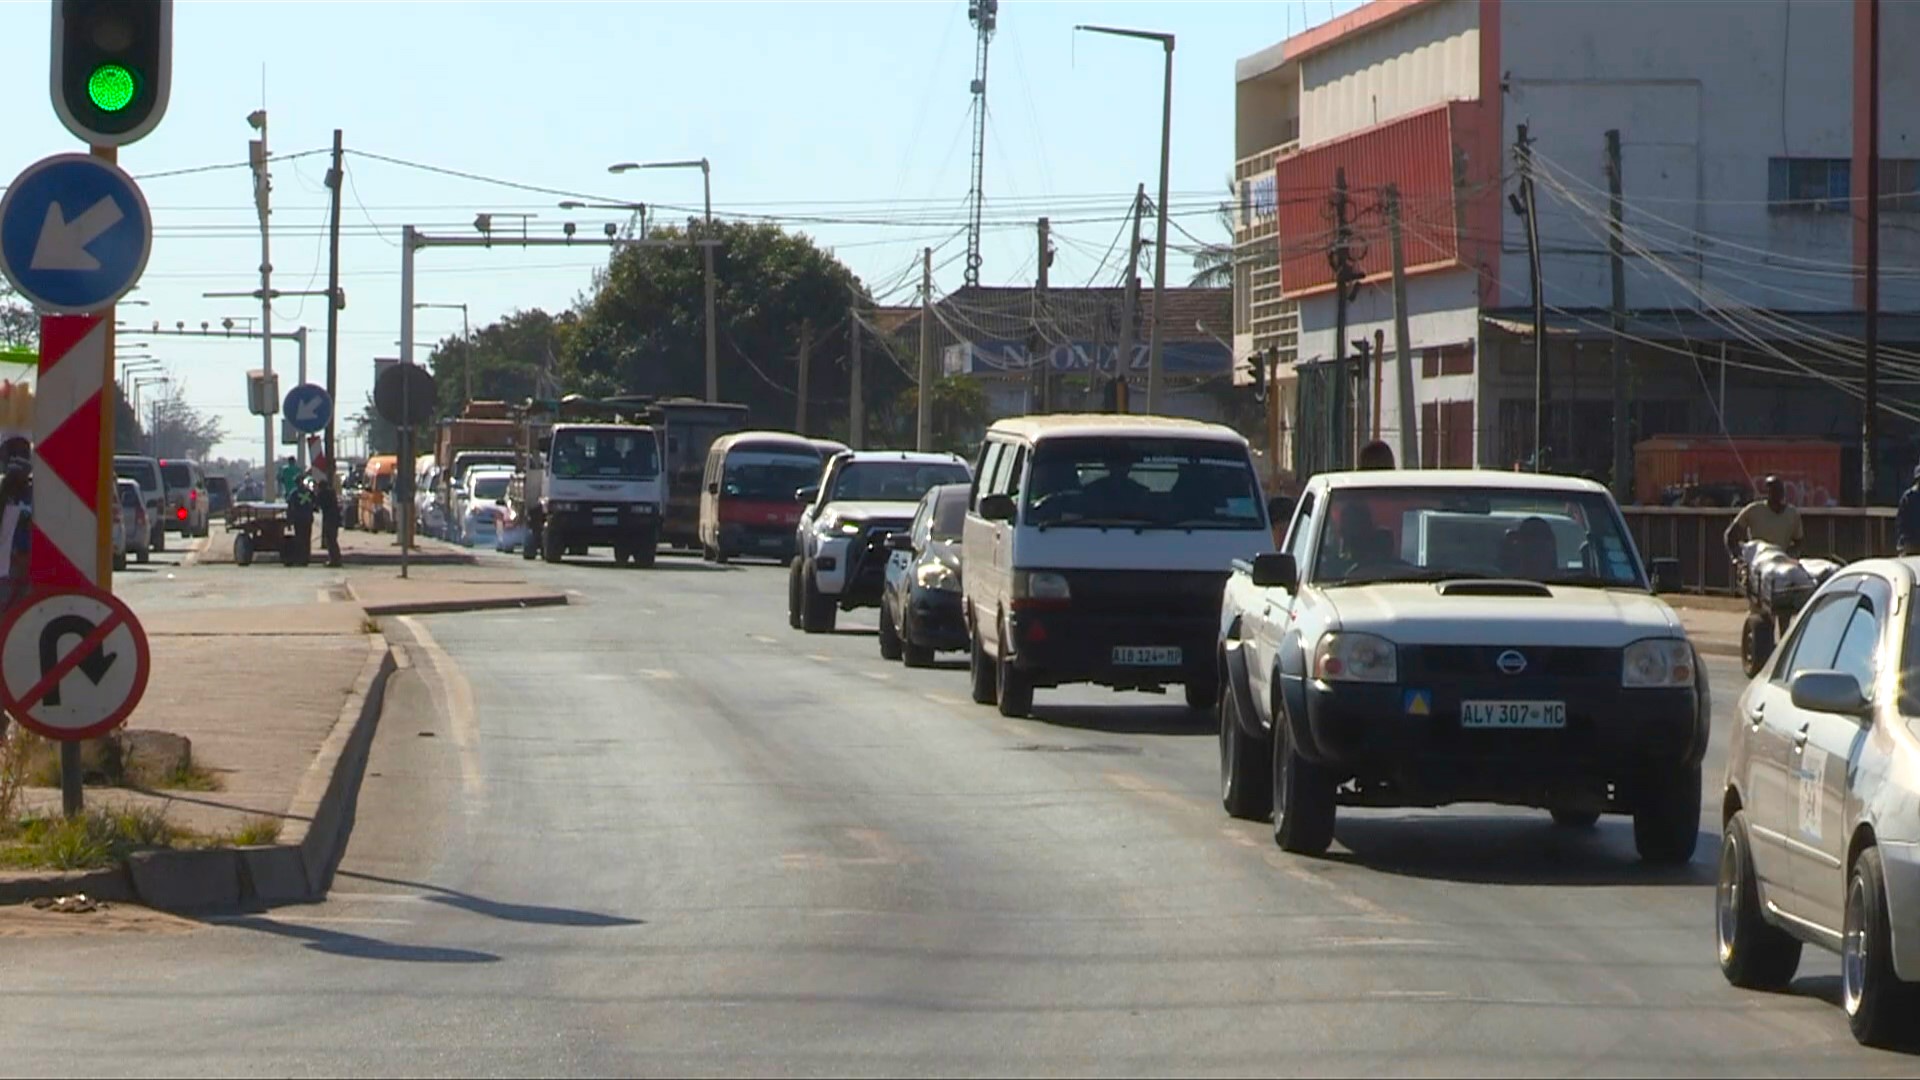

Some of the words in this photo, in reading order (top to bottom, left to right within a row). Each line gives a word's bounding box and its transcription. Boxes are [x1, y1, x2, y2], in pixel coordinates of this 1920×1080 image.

[1463, 704, 1494, 724] ALY
[1498, 704, 1529, 724] 307
[1543, 704, 1564, 724] MC
